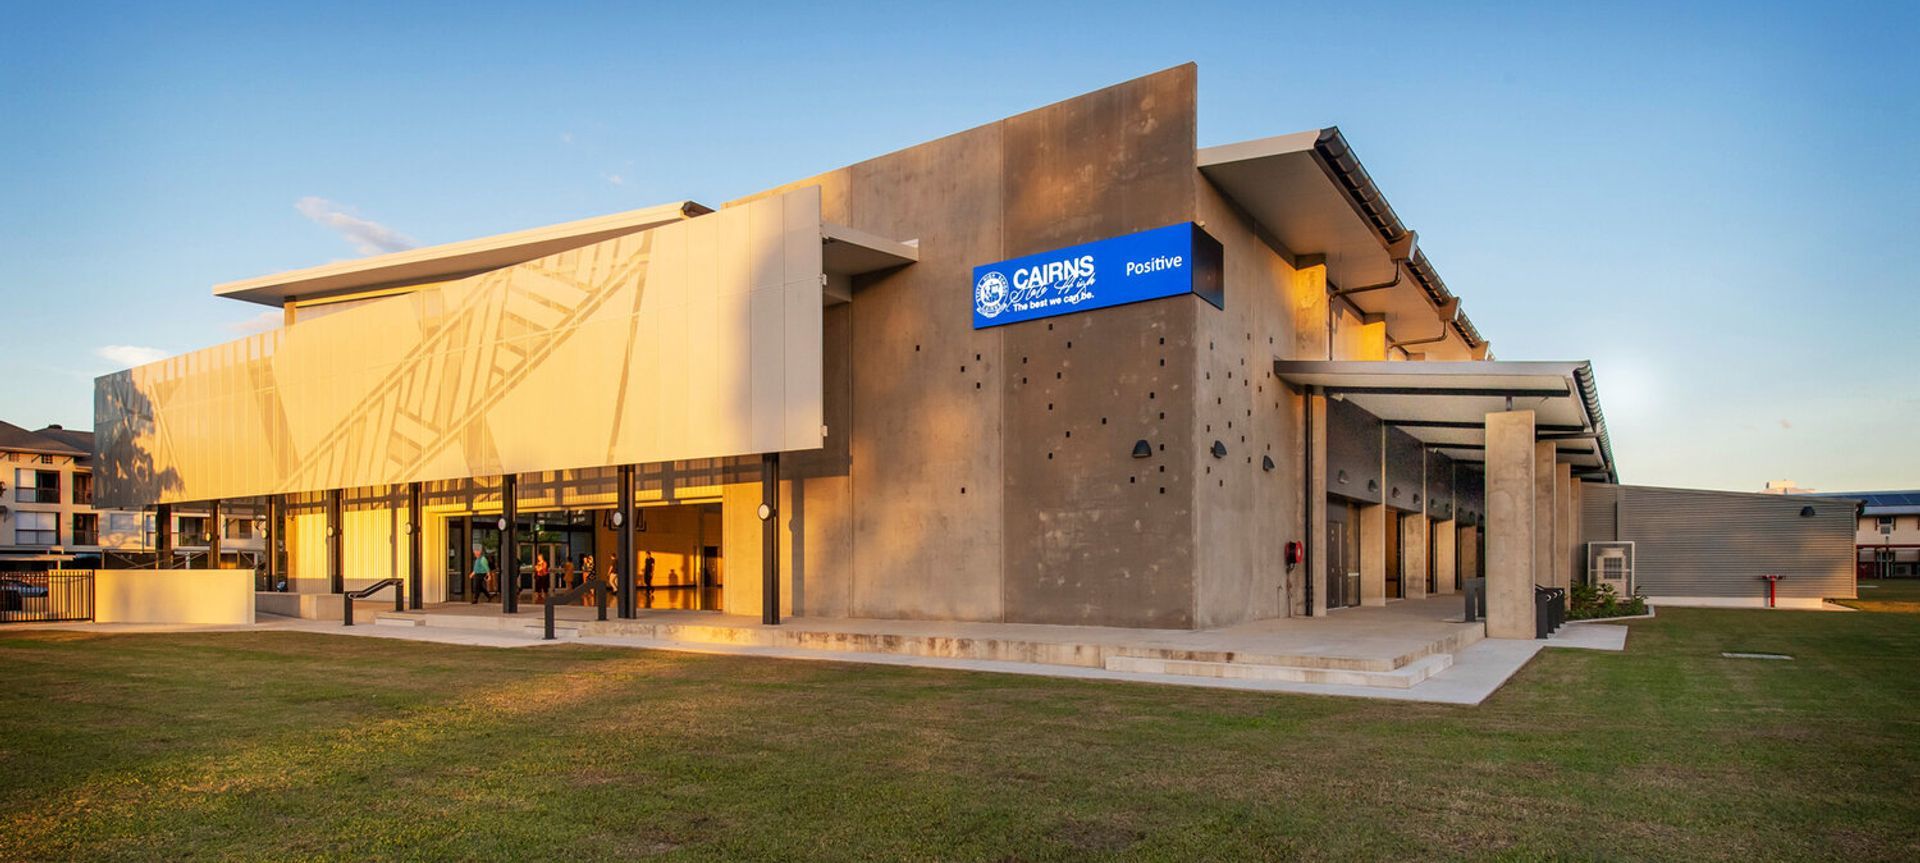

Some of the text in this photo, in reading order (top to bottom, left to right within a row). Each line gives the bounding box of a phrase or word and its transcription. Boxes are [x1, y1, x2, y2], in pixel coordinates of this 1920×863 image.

[1013, 255, 1095, 289] CAIRNS
[1126, 254, 1183, 276] Positive
[1008, 284, 1048, 306] State
[1054, 272, 1096, 304] High
[1013, 291, 1095, 312] The best we can be.
